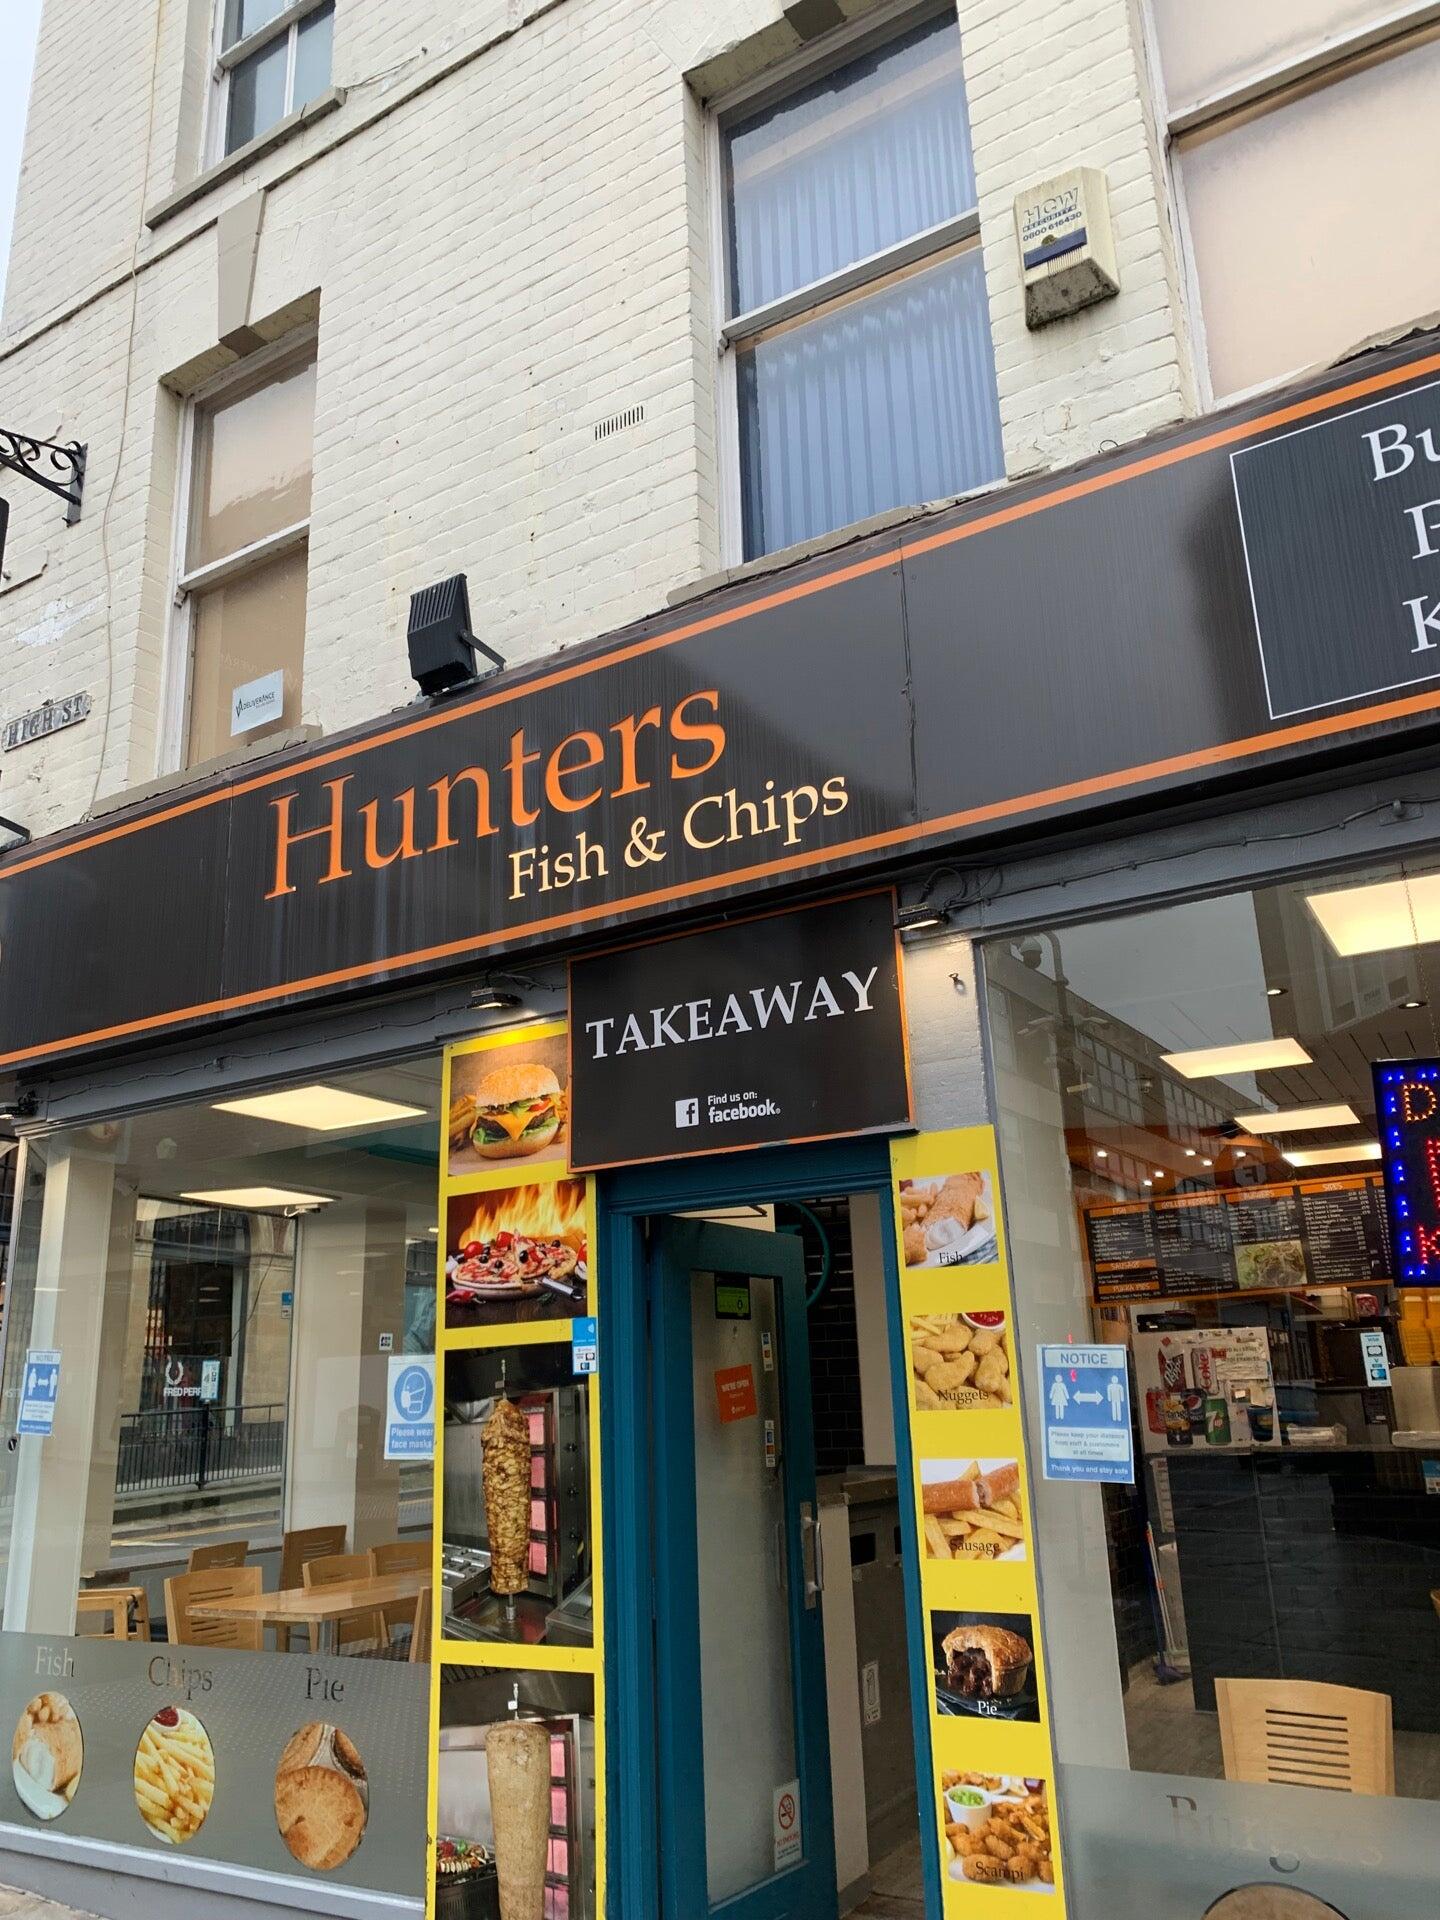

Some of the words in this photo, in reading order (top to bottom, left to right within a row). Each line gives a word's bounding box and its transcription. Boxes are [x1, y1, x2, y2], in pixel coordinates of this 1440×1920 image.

[1023, 227, 1047, 242] 0800
[8, 707, 54, 747] HIGH
[62, 695, 84, 724] ST
[264, 689, 727, 900] Hunters
[508, 831, 609, 900] Fish
[624, 816, 668, 869] &
[683, 776, 850, 848] Chips
[585, 967, 879, 1060] TAKEAWAY
[708, 1093, 727, 1105] Find
[729, 1094, 741, 1102] us
[743, 1091, 758, 1100] on:
[939, 1251, 963, 1264] Fish
[1060, 1353, 1108, 1365] NOTICE
[163, 1387, 182, 1397] FRED
[938, 1389, 989, 1405] Nuggets
[391, 1427, 415, 1438] Please
[391, 1439, 407, 1449] face
[1051, 1464, 1070, 1472] Thank
[1071, 1466, 1085, 1474] you
[1085, 1465, 1098, 1473] and
[1099, 1466, 1114, 1475] stay
[950, 1540, 1000, 1556] Sausage
[34, 1646, 75, 1678] Fish
[149, 1656, 213, 1701] Chips
[304, 1667, 345, 1702] Pie
[977, 1700, 998, 1716] Pie
[975, 1861, 1025, 1884] Scampi
